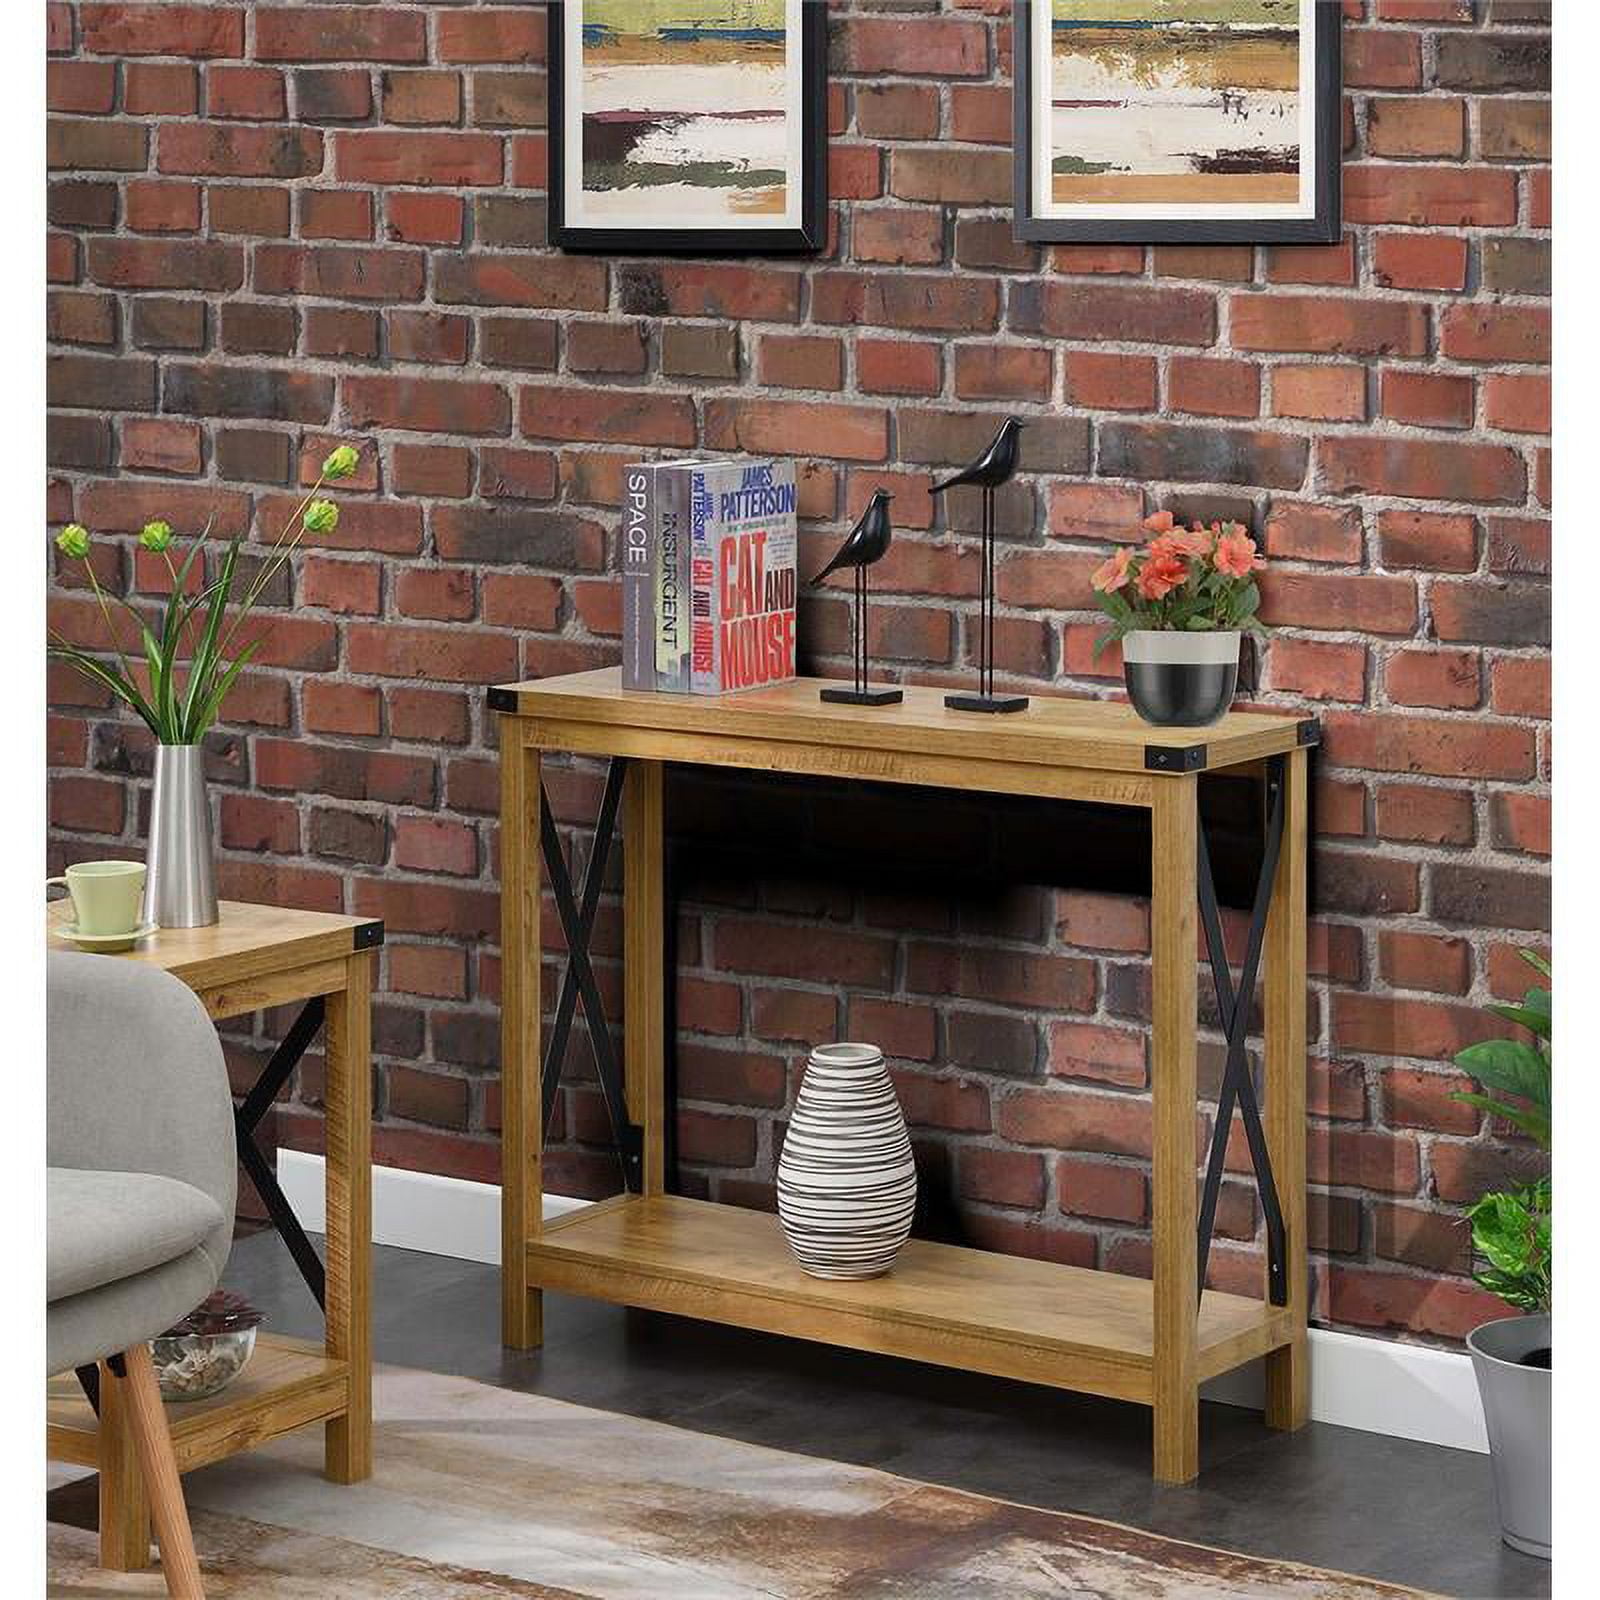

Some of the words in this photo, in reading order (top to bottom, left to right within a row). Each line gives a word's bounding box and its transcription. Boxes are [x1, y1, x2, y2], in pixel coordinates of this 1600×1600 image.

[628, 474, 647, 563] SPACE
[720, 483, 796, 523] PATTERSON
[662, 512, 677, 649] INSURGENT
[719, 531, 767, 620] CAT
[765, 568, 795, 613] AND
[720, 612, 796, 690] MOUSE
